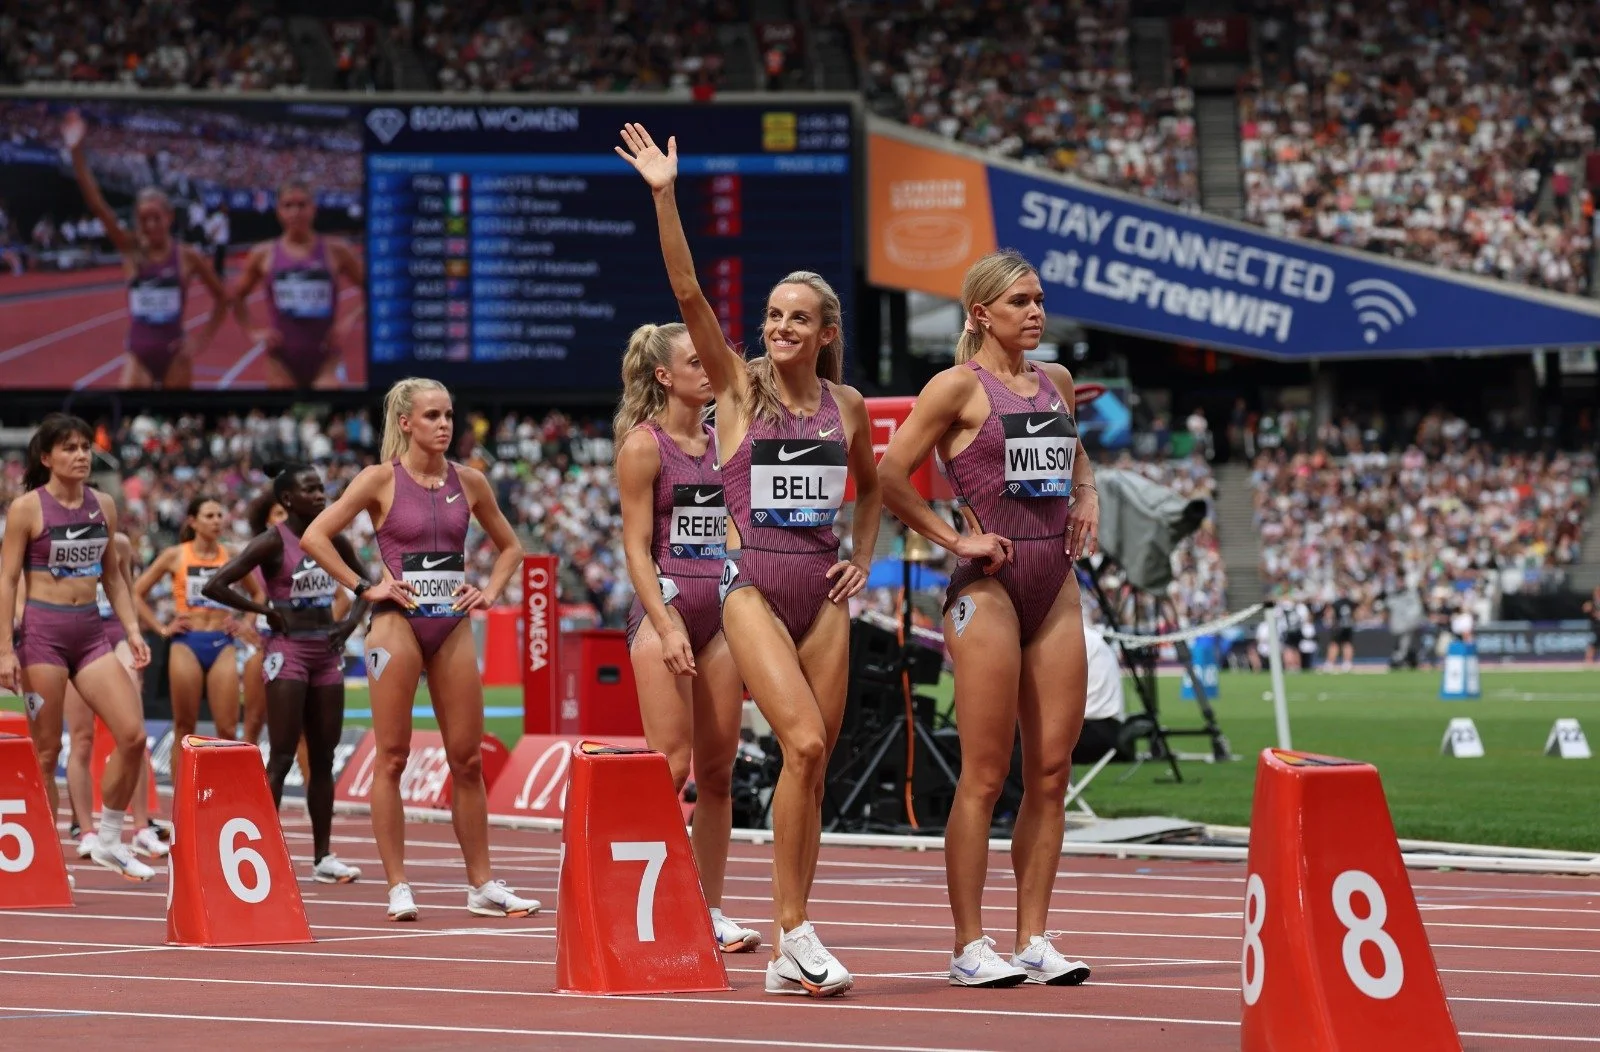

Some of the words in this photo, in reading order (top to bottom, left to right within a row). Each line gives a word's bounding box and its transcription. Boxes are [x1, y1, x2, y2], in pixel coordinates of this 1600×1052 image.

[1018, 190, 1113, 245] STAY
[1112, 214, 1335, 303] CONNECTED
[1040, 249, 1083, 288] at
[1008, 446, 1073, 472] WILSON
[772, 475, 829, 500] BELL
[677, 515, 727, 537] REEKIE
[789, 511, 831, 523] LONDON
[55, 545, 102, 563] BISSET
[959, 601, 966, 622] 9
[528, 596, 548, 673] OMEGA
[370, 652, 378, 668] 7
[0, 799, 34, 873] 5
[218, 817, 272, 904] 6
[610, 841, 668, 942] 7
[1241, 873, 1266, 1006] 8
[1331, 870, 1404, 999] 8
